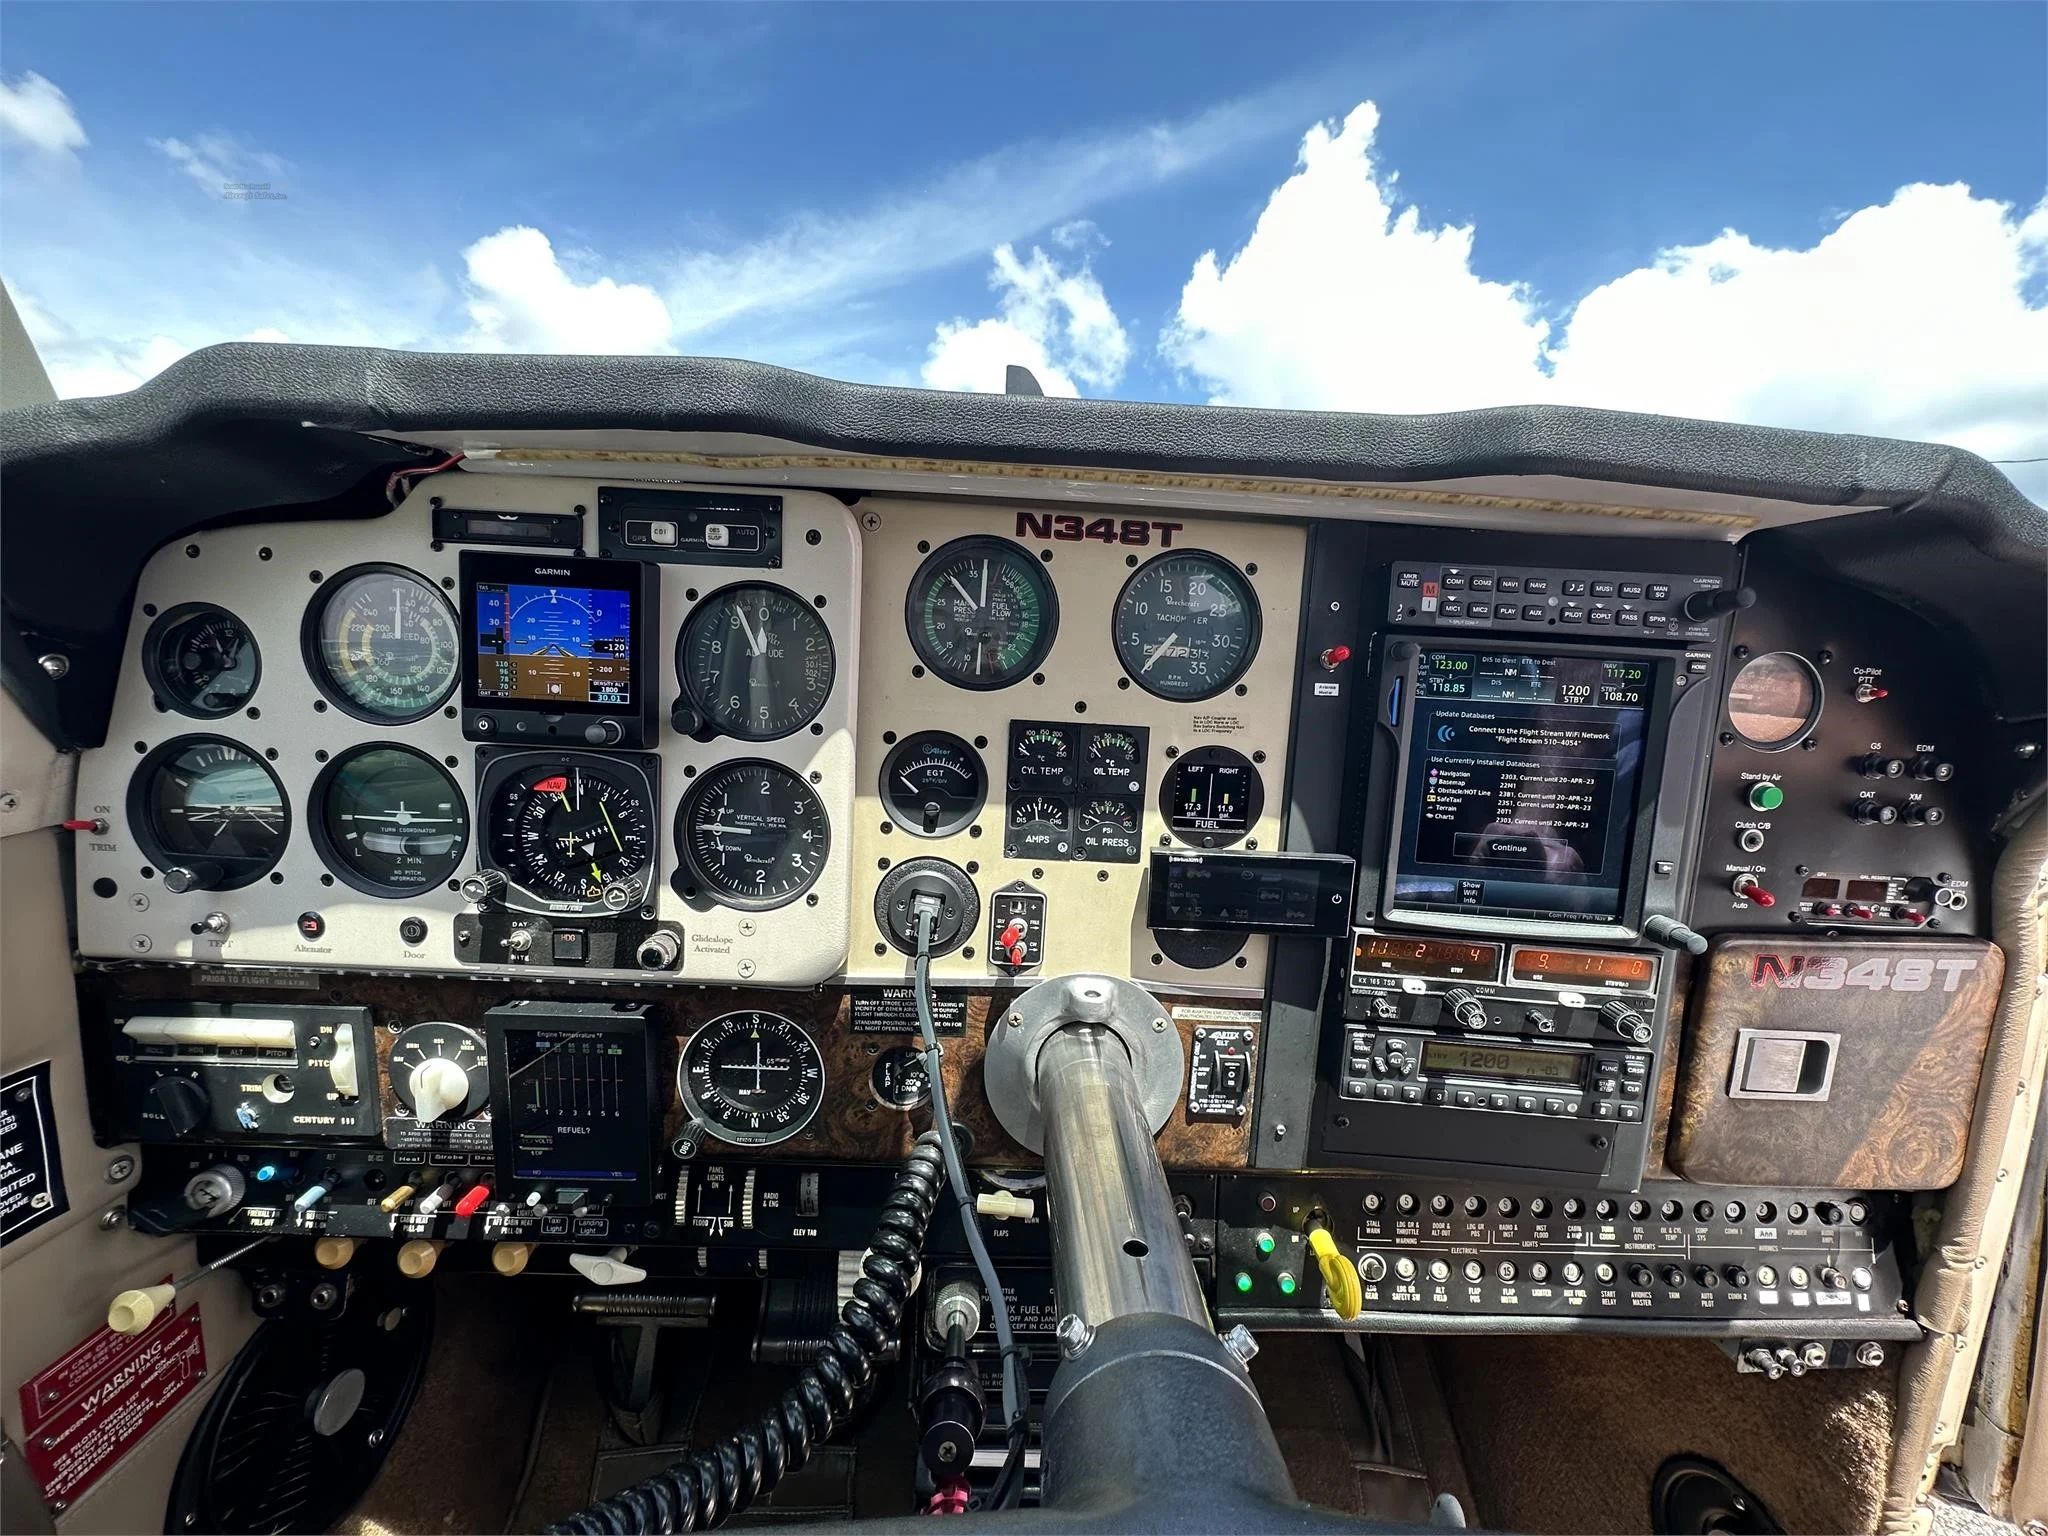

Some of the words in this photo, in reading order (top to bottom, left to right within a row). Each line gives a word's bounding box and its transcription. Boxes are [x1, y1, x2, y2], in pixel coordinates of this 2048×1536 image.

[1016, 511, 1183, 547] N348T
[535, 568, 570, 576] GARMIN
[1189, 582, 1206, 595] 20
[1210, 604, 1227, 617] 25
[730, 616, 740, 629] 9
[1212, 635, 1230, 648] 30
[712, 641, 721, 654] 8
[746, 649, 784, 658] ALUDE
[1435, 660, 1468, 670] 123.00
[1607, 669, 1641, 679] 117.20
[1853, 667, 1882, 676] Co-Pilot
[1433, 683, 1465, 692] 118.85
[1561, 685, 1590, 696] 1200
[597, 694, 621, 702] 30.01
[1604, 692, 1638, 702] 108.70
[760, 707, 769, 719] 5
[1469, 726, 1496, 734] Connect
[1519, 728, 1539, 737] Flight
[1519, 737, 1542, 745] Stream
[1444, 756, 1475, 765] Currently
[1506, 760, 1540, 768] Databases
[927, 769, 944, 777] EGT
[1021, 766, 1037, 774] CYL
[1041, 767, 1063, 775] TEMP
[1559, 777, 1594, 785] 20-APR-23
[1741, 773, 1761, 781] Stand
[547, 781, 562, 789] NAV
[94, 805, 111, 813] ON
[533, 807, 546, 819] 30
[737, 814, 764, 822] VERTICAL
[1735, 821, 1757, 829] Clutch
[802, 830, 813, 842] 4
[1025, 835, 1050, 843] AMPS
[1085, 837, 1098, 845] OIL
[1102, 838, 1129, 847] PRESS
[89, 843, 116, 851] TRIM
[1492, 844, 1527, 852] Continue
[694, 945, 730, 954] Activated
[404, 951, 426, 959] Door
[1751, 953, 1977, 992] N348T
[201, 975, 222, 984] PRIOR
[225, 976, 235, 984] TO
[238, 976, 269, 985] FLIGHT
[883, 989, 937, 999] WARNG
[537, 1031, 557, 1039] Engine
[1459, 1052, 1508, 1069] 1200
[293, 1116, 335, 1124] CENTURY
[415, 1121, 475, 1130] WARNING
[558, 1126, 591, 1134] REFUEL?
[763, 1192, 779, 1200] RADIO
[993, 1229, 1009, 1237] FLAPS
[1021, 1306, 1040, 1314] FUEL
[81, 1340, 162, 1411] WARNING
[104, 1401, 138, 1432] MANUAL
